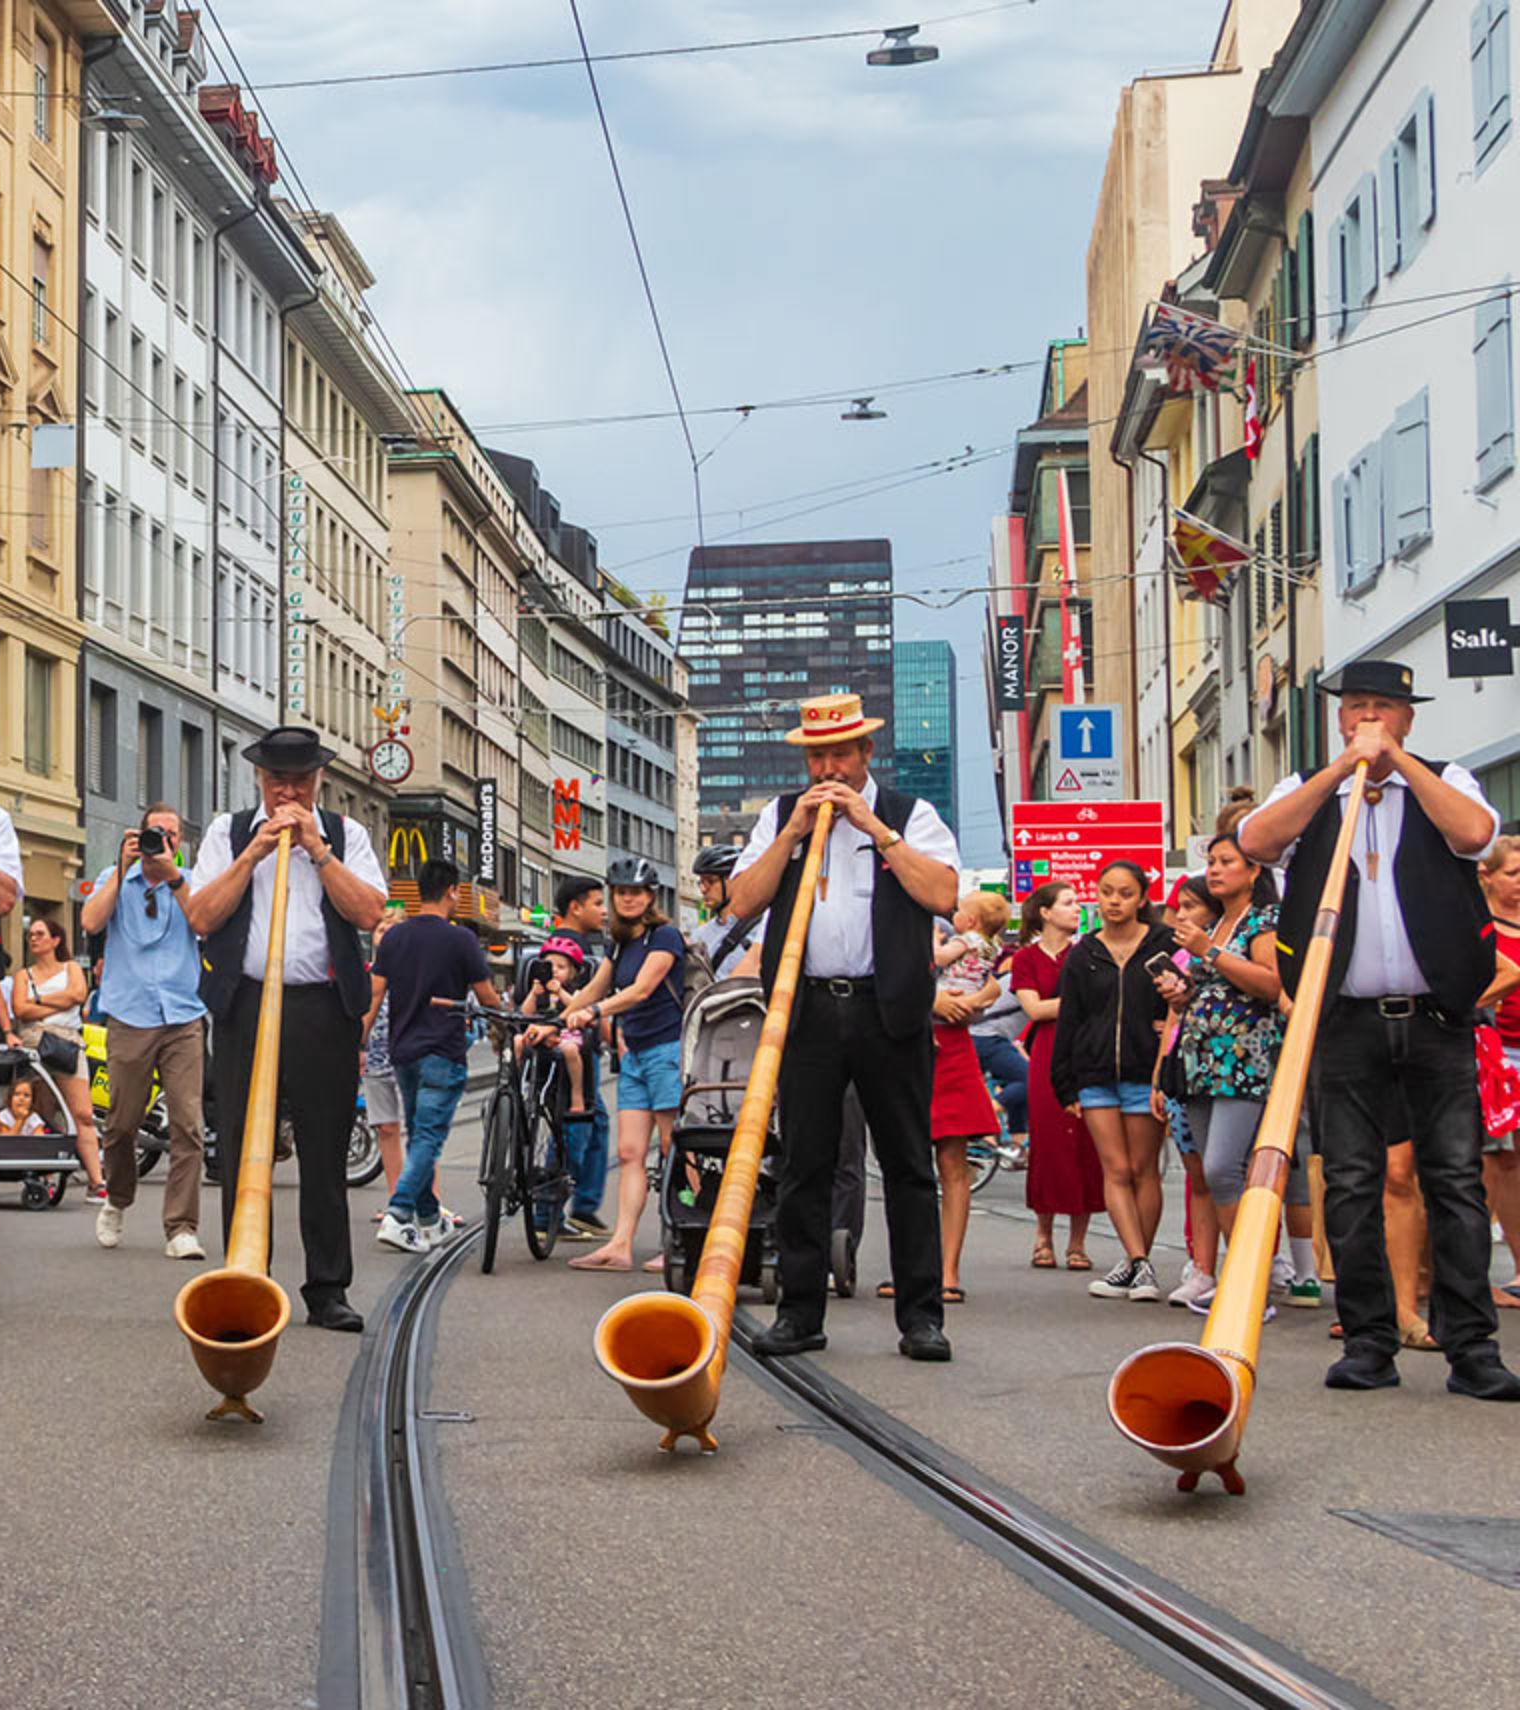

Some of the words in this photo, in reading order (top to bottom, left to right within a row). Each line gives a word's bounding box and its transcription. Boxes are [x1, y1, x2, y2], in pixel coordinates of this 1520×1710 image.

[289, 592, 302, 710] Galerie
[1002, 627, 1019, 699] MANOR
[1451, 628, 1507, 649] Salt.
[481, 784, 494, 880] McDonald's
